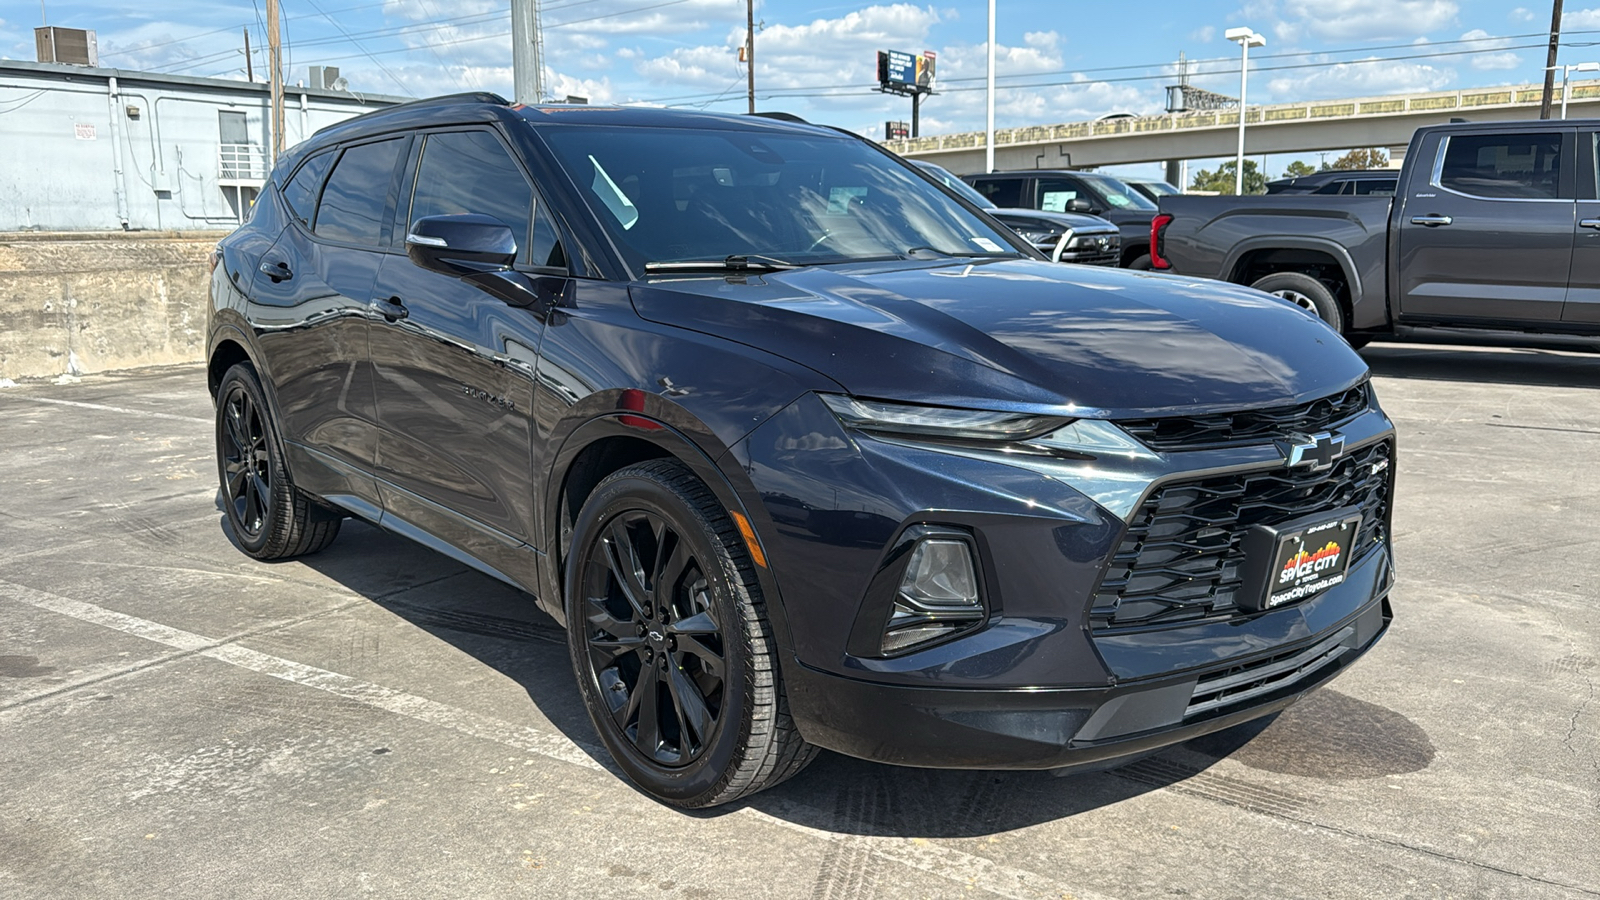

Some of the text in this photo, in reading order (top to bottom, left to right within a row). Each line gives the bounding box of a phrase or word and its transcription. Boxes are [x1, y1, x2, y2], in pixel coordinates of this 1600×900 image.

[462, 386, 515, 411] BLAZER
[1279, 553, 1340, 584] SPACE CITY
[1302, 573, 1319, 583] TOYOTA
[1270, 575, 1343, 605] SpaceCityToyota.com
